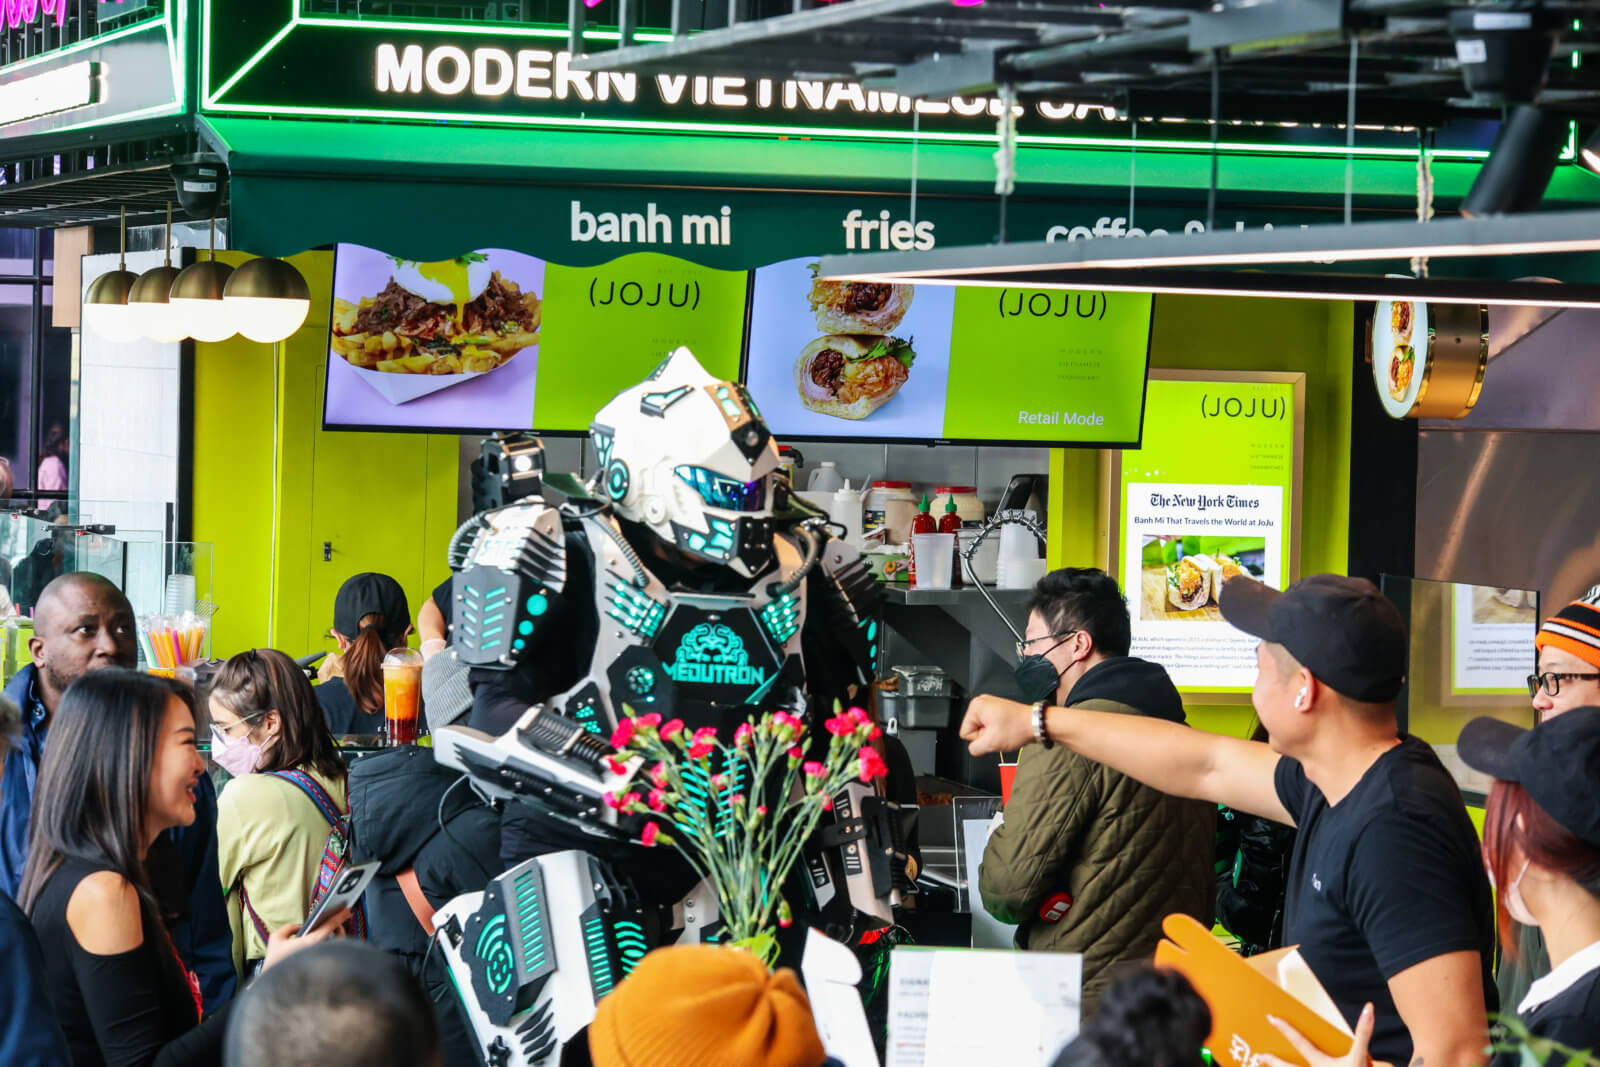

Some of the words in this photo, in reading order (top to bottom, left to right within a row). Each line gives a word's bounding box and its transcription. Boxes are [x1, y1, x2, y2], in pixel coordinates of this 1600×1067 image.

[375, 43, 638, 102] MODERN
[571, 200, 672, 244] banh
[682, 205, 732, 246] mi
[842, 208, 936, 251] fries
[590, 277, 700, 311] (JOJU)
[1000, 288, 1107, 321] (JOJU)
[1018, 410, 1060, 425] Retail
[1063, 411, 1105, 426] Mode
[1201, 394, 1286, 420] (JOJU)
[1150, 493, 1171, 508] The
[1172, 494, 1196, 507] New
[1197, 495, 1225, 511] York
[1226, 494, 1260, 508] Times
[1134, 516, 1154, 525] Banh
[1154, 517, 1165, 525] Mi
[1166, 517, 1183, 526] That
[1184, 517, 1210, 526] Travels
[1211, 518, 1223, 526] the
[1224, 519, 1247, 527] World
[1248, 519, 1257, 527] at
